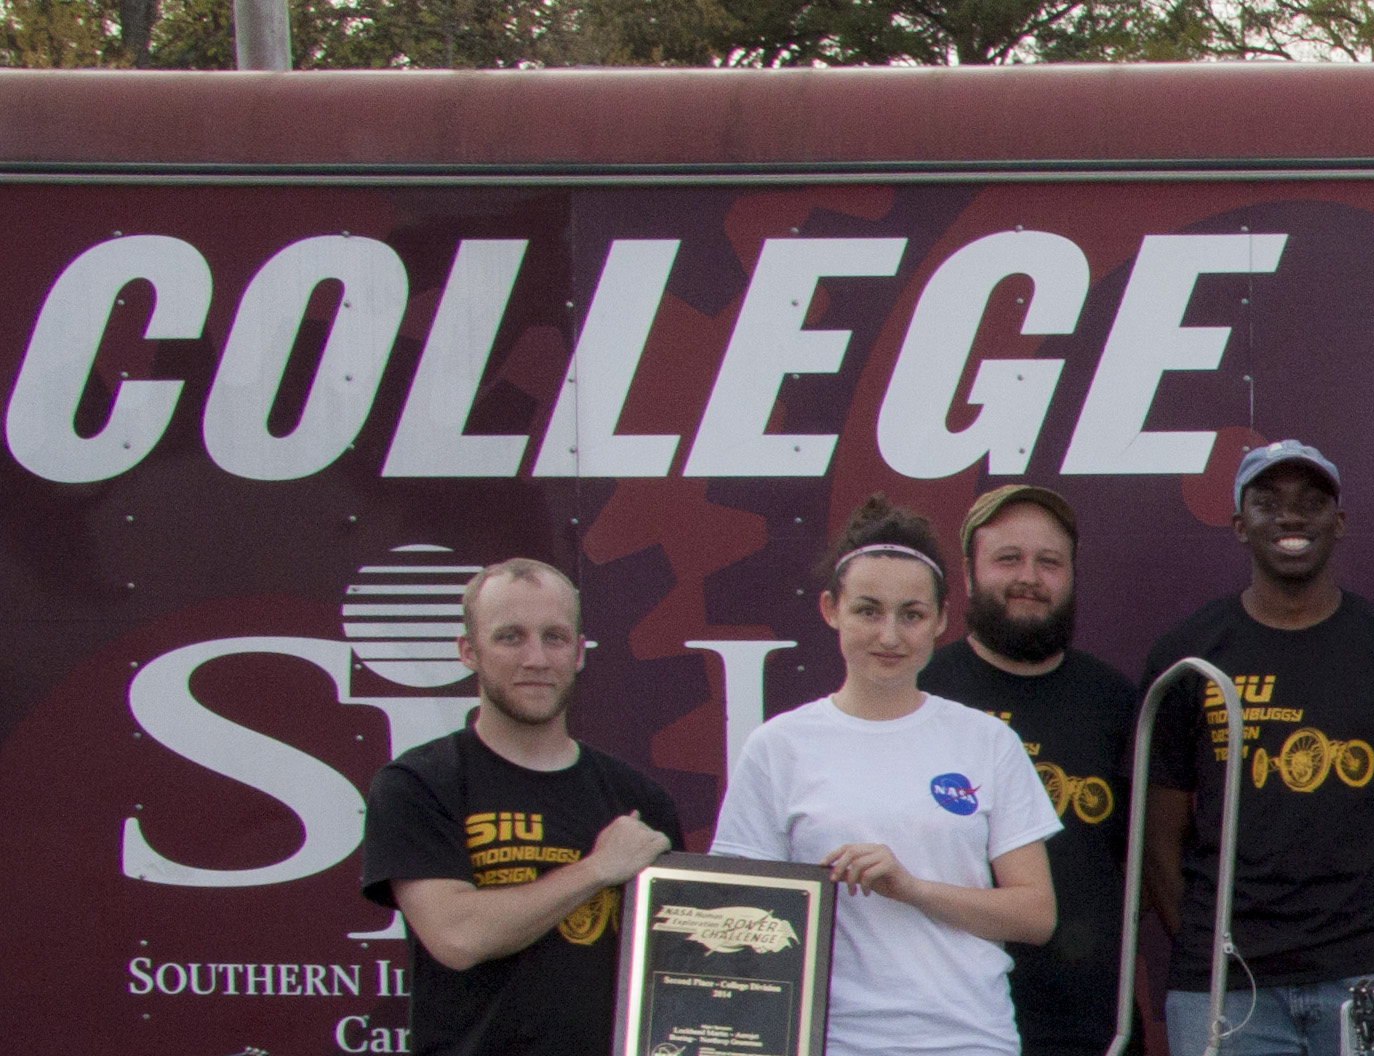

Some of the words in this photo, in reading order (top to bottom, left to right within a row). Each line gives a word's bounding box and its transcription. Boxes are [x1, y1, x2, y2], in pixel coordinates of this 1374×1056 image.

[3, 229, 1289, 483] COLLEGE
[933, 784, 977, 805] NASA
[465, 811, 544, 849] SIU
[470, 845, 582, 867] MOONBUGGY
[473, 866, 539, 887] DESIGN
[664, 907, 695, 917] NASA
[671, 917, 721, 929] Exploration
[720, 916, 780, 933] ROVER
[700, 929, 778, 945] CHALLENGE
[128, 957, 361, 997] SOUTHERN
